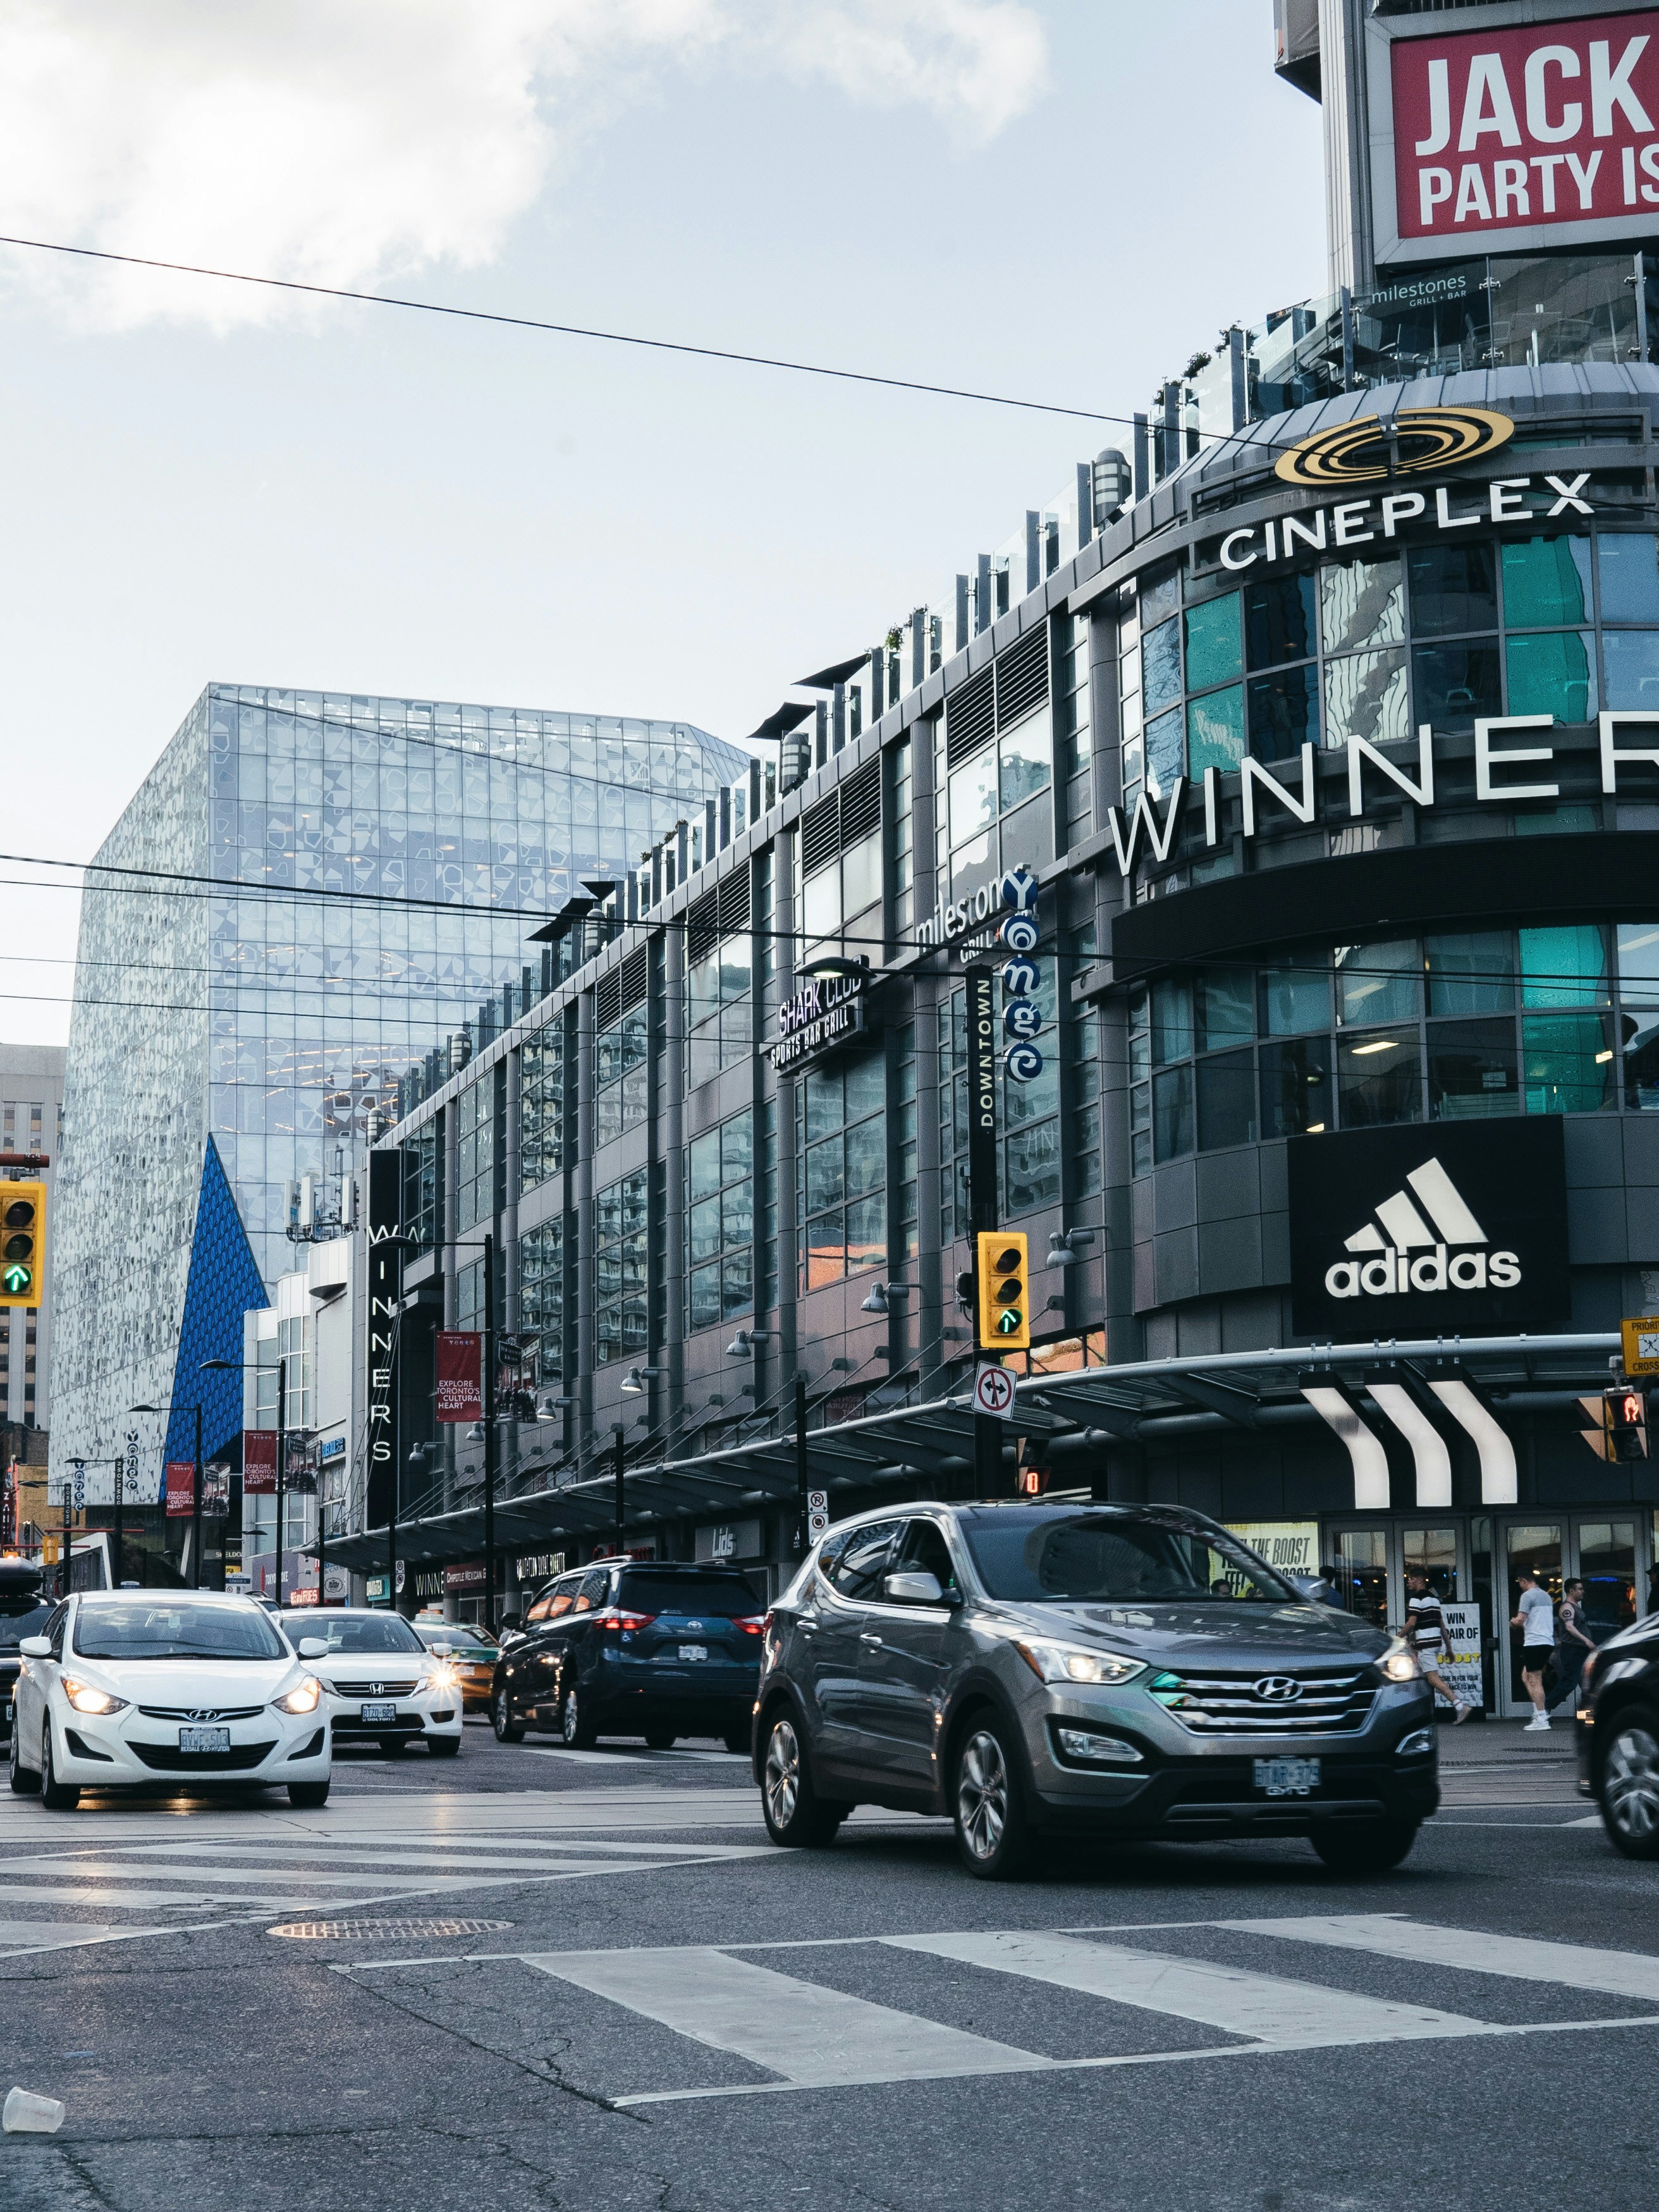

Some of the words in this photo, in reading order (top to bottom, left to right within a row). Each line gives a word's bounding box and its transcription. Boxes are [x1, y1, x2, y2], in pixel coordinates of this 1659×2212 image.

[1415, 35, 1655, 157] JACK
[1418, 150, 1603, 226] PARTY
[1371, 275, 1466, 305] milestones
[1409, 297, 1437, 307] GRILL
[1448, 290, 1467, 300] BAR
[1220, 472, 1595, 570] CINEPLEX
[779, 978, 823, 1037] SHARK
[771, 1033, 800, 1070] SPORTS
[804, 1021, 821, 1050] BAR
[824, 1005, 848, 1038] GRILL
[977, 979, 993, 1127] DOWNTOWN
[1325, 1243, 1521, 1298] adidas
[367, 1225, 399, 1461] WINNERS
[712, 1526, 737, 1557] Lids
[1272, 1537, 1311, 1565] BOOST
[1446, 1612, 1466, 1624] WIN
[1466, 1627, 1478, 1639] OF
